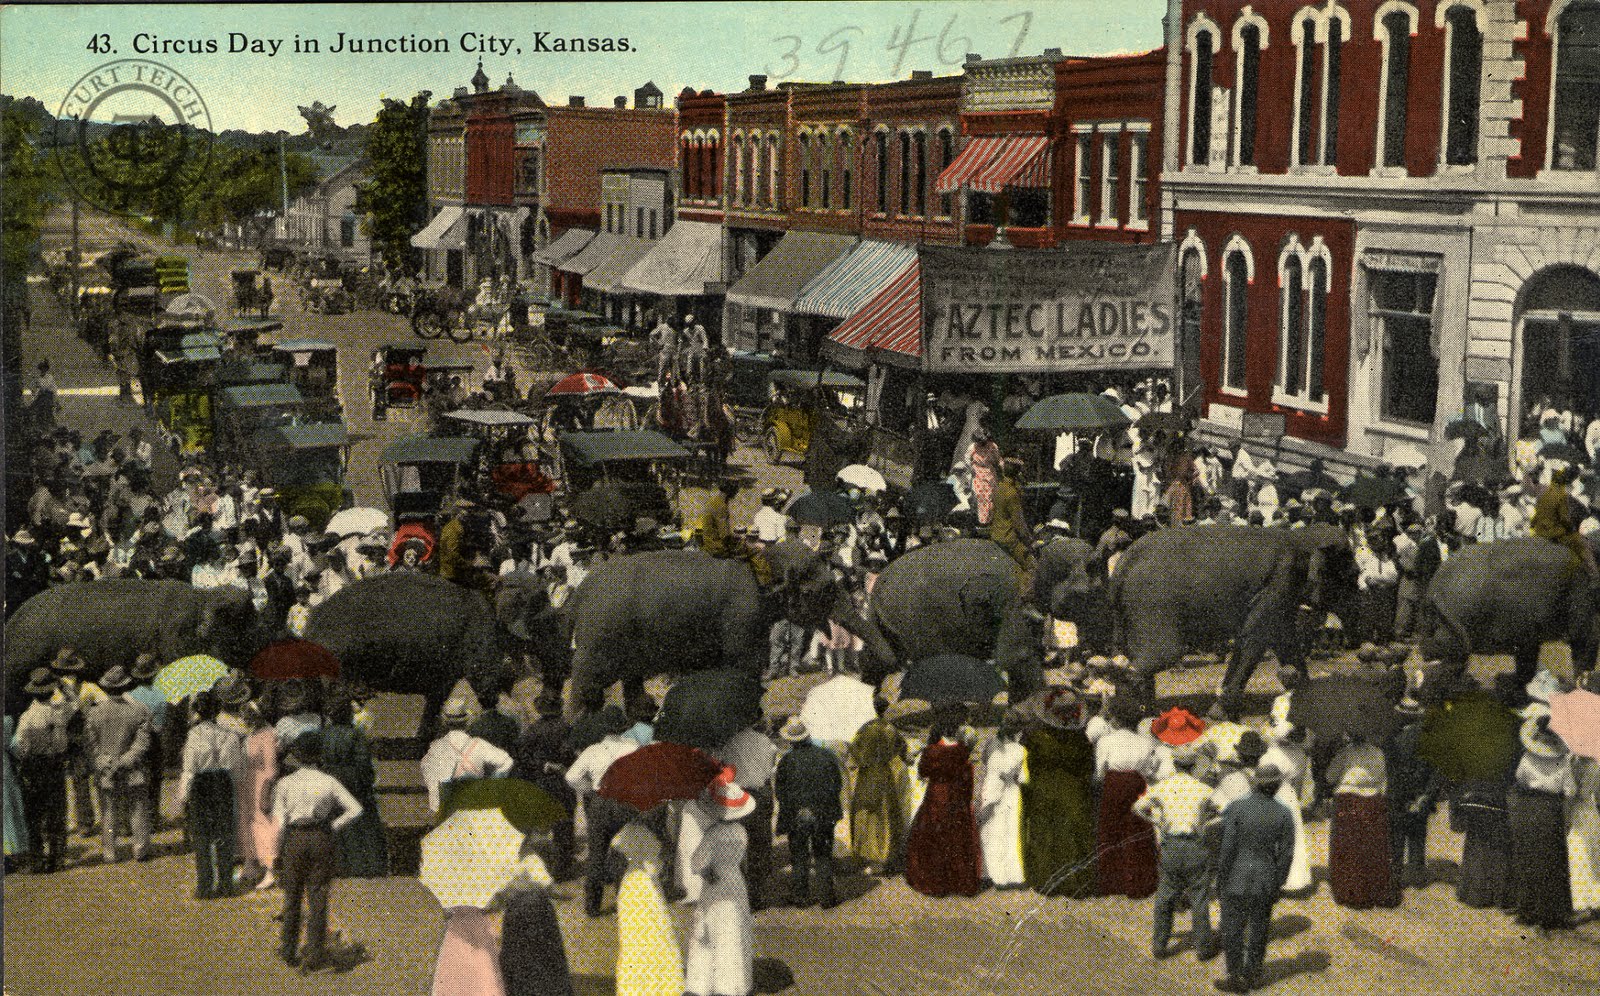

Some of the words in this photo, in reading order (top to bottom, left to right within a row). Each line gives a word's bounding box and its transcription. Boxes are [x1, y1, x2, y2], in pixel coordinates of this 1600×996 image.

[764, 8, 1033, 82] 39467
[947, 302, 1045, 339] AZTEC
[1056, 301, 1171, 338] LADIES
[941, 345, 1021, 362] FROM
[1036, 342, 1160, 362] MEXICO.
